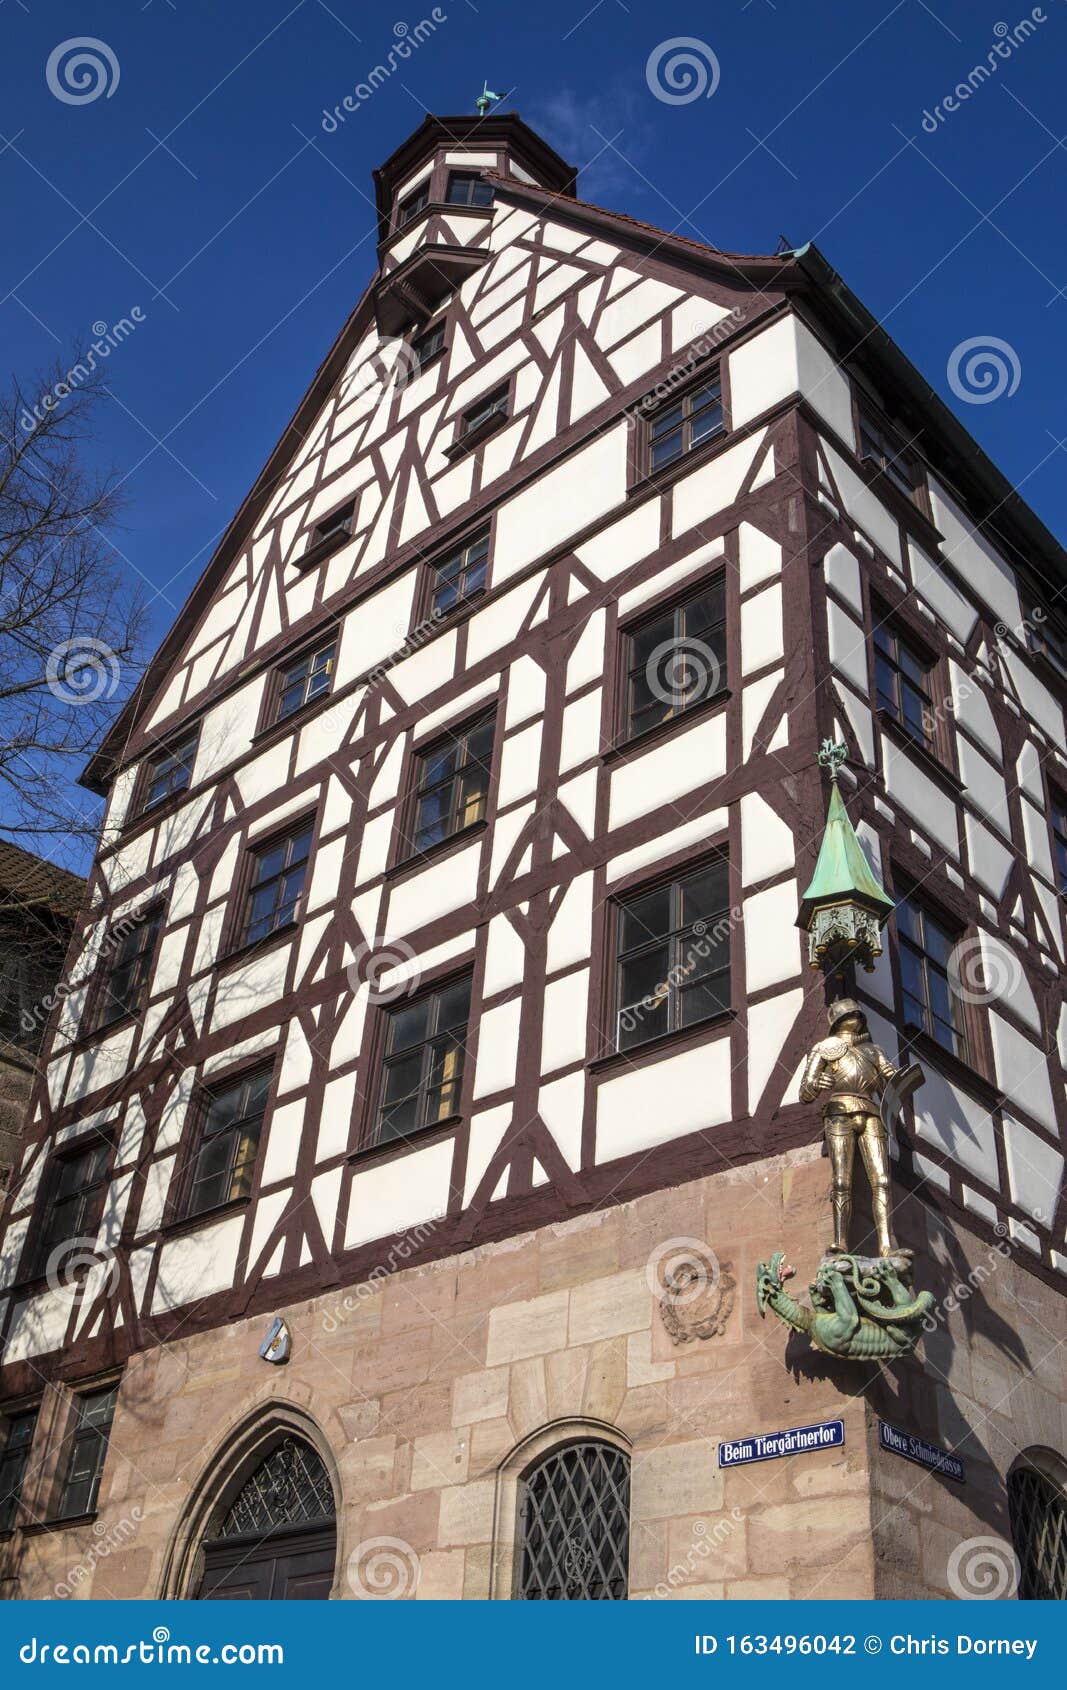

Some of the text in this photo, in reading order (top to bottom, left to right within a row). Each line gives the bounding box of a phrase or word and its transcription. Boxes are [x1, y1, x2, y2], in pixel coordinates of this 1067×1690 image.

[725, 1427, 836, 1462] Beim Tiergärtnertor
[883, 1425, 908, 1451] Obere
